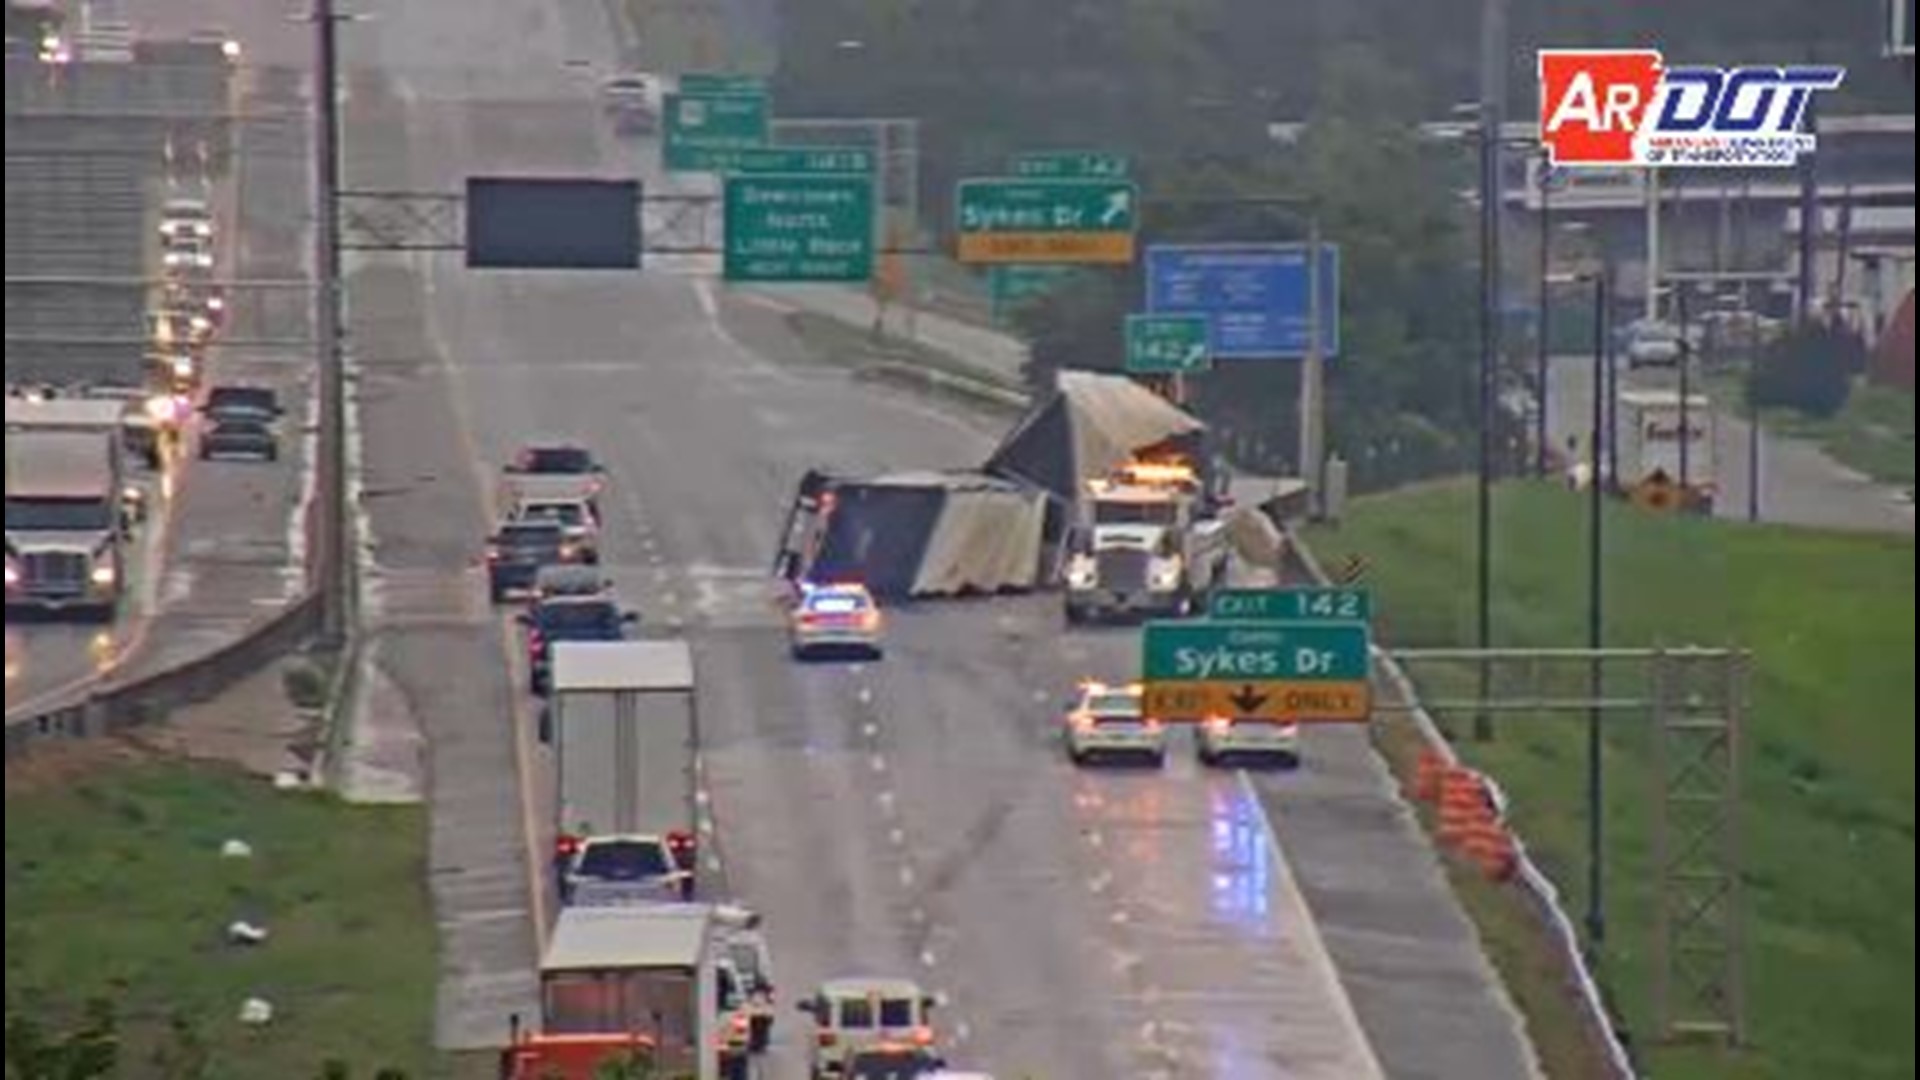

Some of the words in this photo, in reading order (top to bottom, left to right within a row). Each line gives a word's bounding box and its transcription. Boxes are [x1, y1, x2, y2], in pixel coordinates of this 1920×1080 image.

[1297, 592, 1360, 616] 142
[1173, 645, 1278, 678] Sykes
[1296, 648, 1333, 673] Dr
